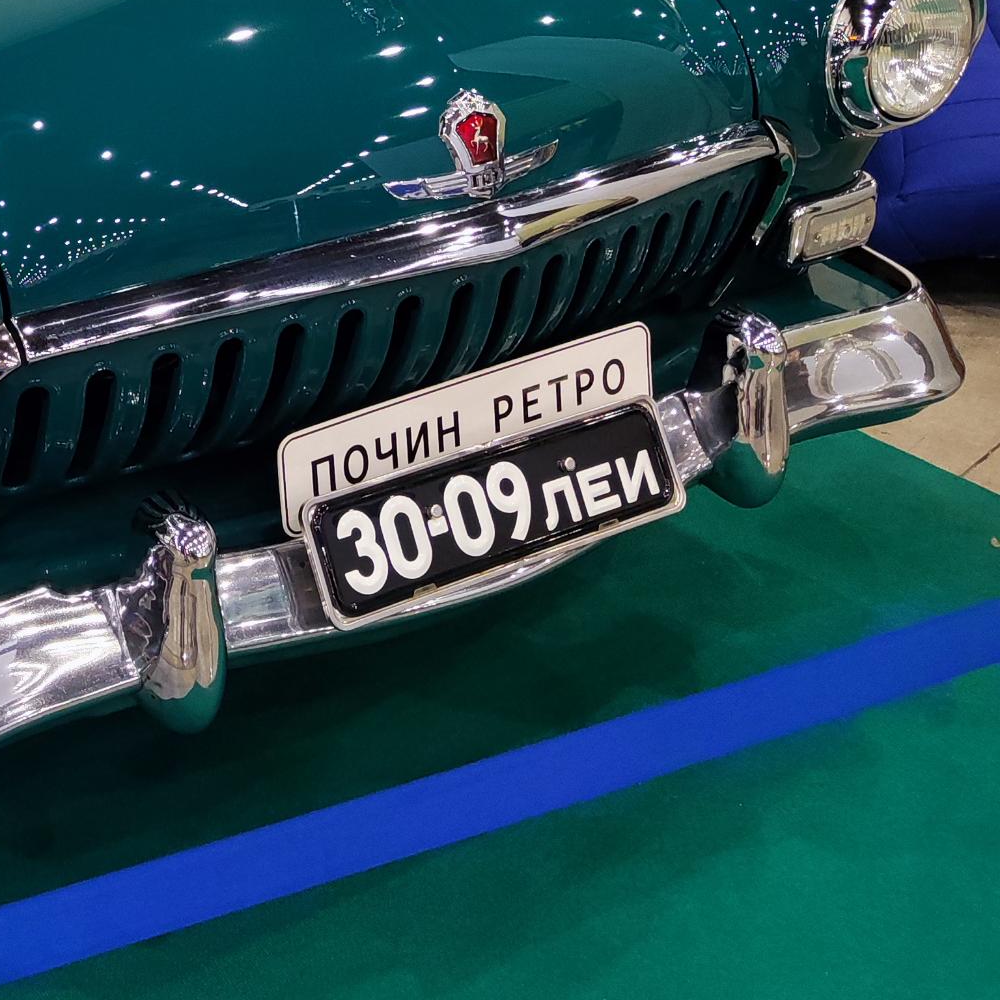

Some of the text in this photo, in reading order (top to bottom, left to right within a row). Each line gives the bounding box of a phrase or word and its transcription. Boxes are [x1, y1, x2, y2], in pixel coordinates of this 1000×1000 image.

[311, 358, 626, 497] ПОЧИН РЕТРО
[336, 460, 532, 596] 30-09
